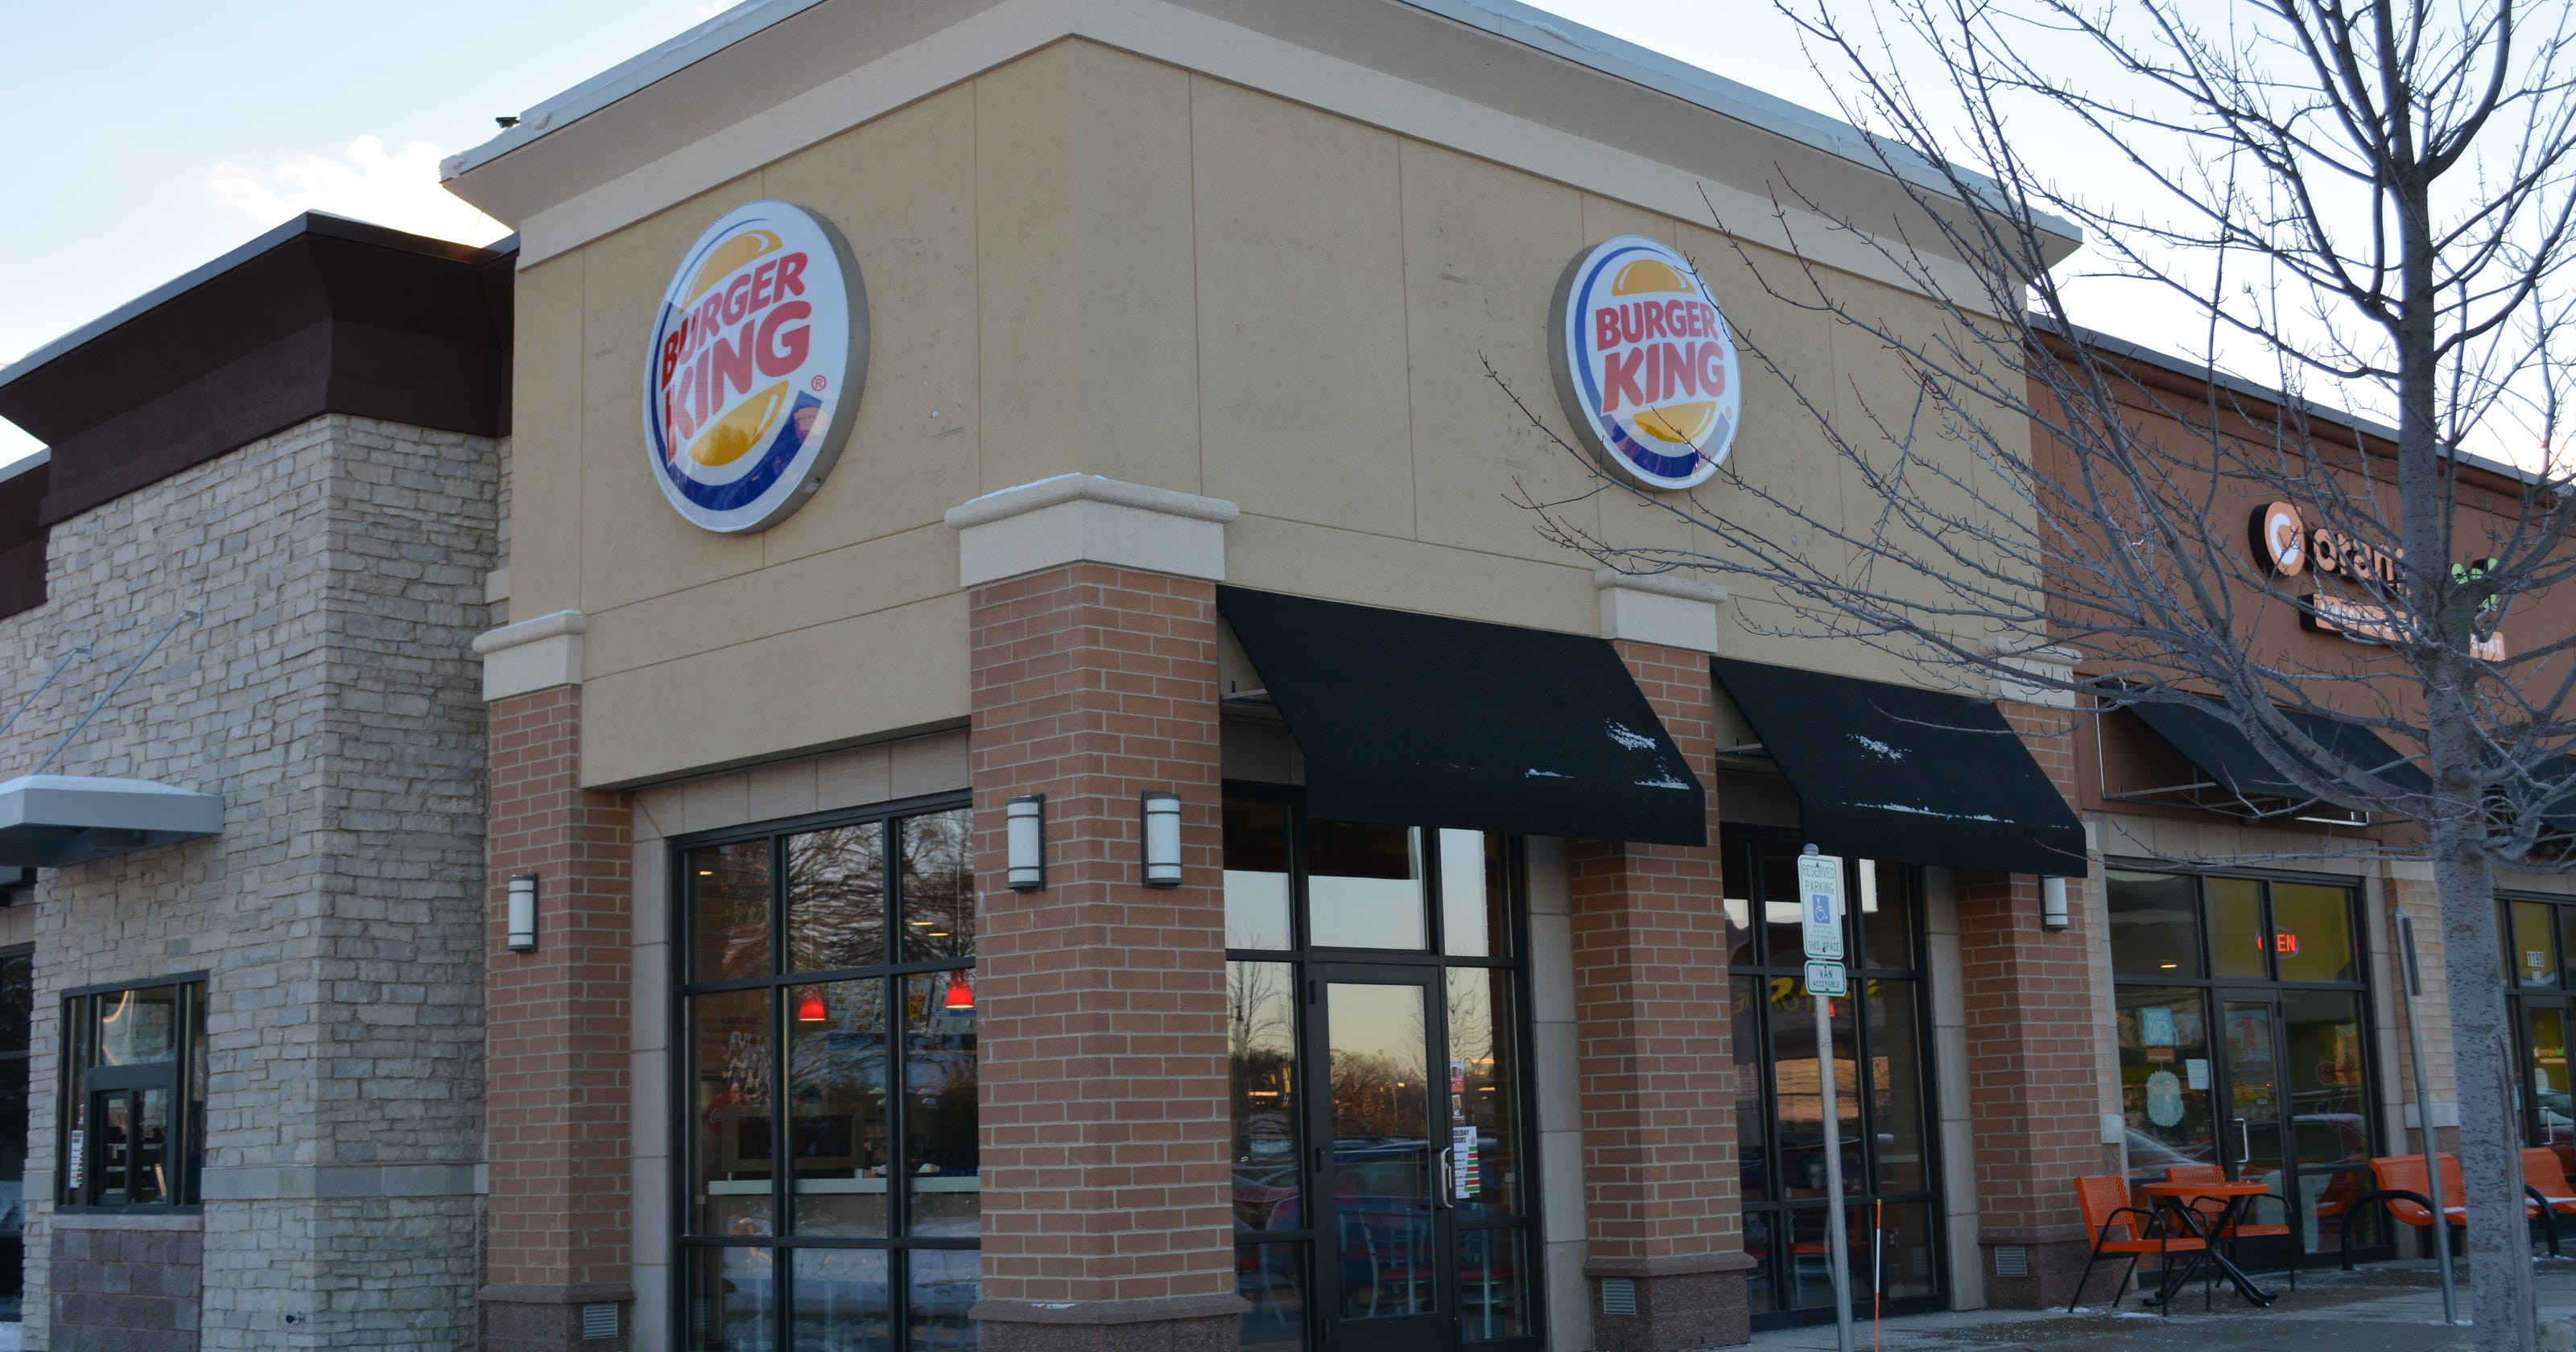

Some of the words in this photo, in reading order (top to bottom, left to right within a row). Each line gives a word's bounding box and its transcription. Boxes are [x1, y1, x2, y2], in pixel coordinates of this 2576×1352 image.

[663, 252, 808, 392] BURGER
[1596, 299, 1719, 351] BURGER
[665, 300, 812, 464] KING
[1602, 340, 1725, 414] KING
[1802, 864, 1835, 879] RESERVED
[1805, 880, 1834, 894] PARKING
[1808, 940, 1820, 950] THIS
[1823, 942, 1840, 952] SPACE
[1818, 969, 1833, 979] VAN
[1813, 980, 1840, 988] ACCESSIBLE
